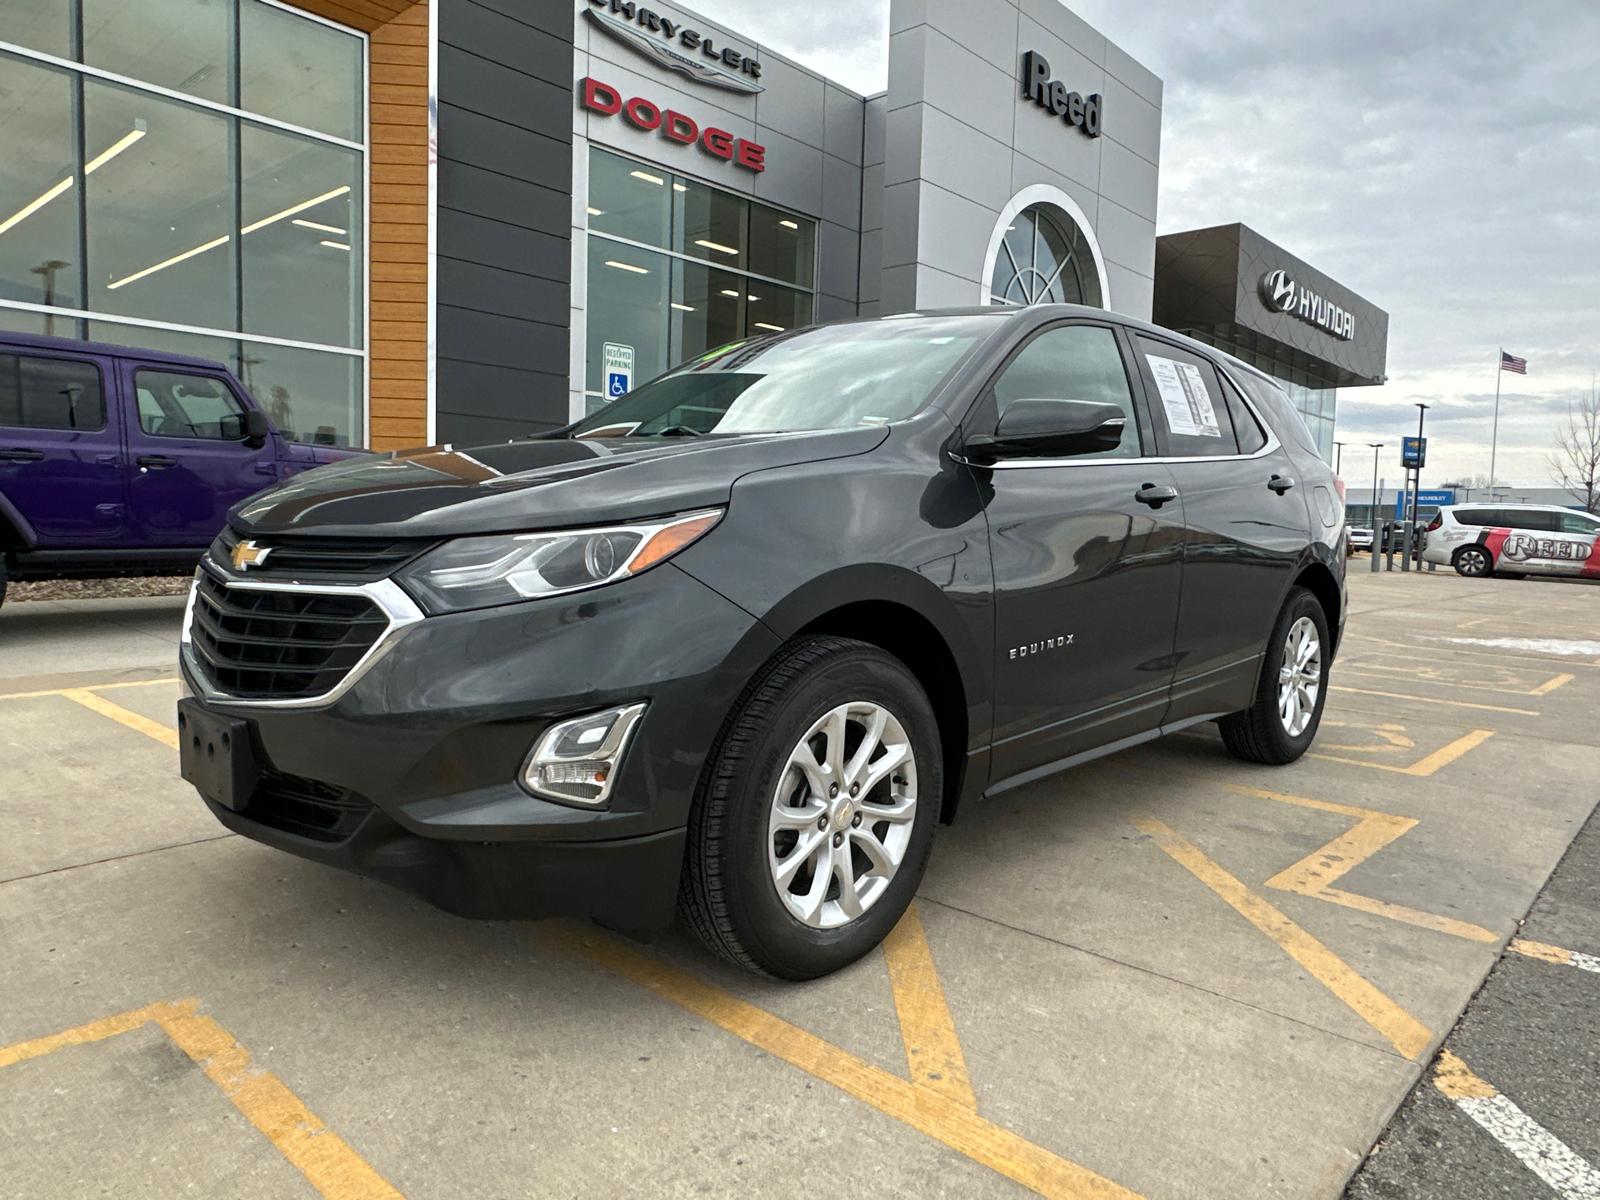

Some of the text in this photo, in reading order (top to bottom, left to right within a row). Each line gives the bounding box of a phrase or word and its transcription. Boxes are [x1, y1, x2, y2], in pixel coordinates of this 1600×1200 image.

[1023, 50, 1102, 138] Reed
[580, 76, 766, 173] DODGE
[1299, 286, 1355, 341] HYUNDAI
[606, 348, 631, 360] RESERVED
[606, 358, 631, 370] PARKING
[1503, 534, 1593, 560] REED
[1008, 633, 1074, 660] EQUINOX
